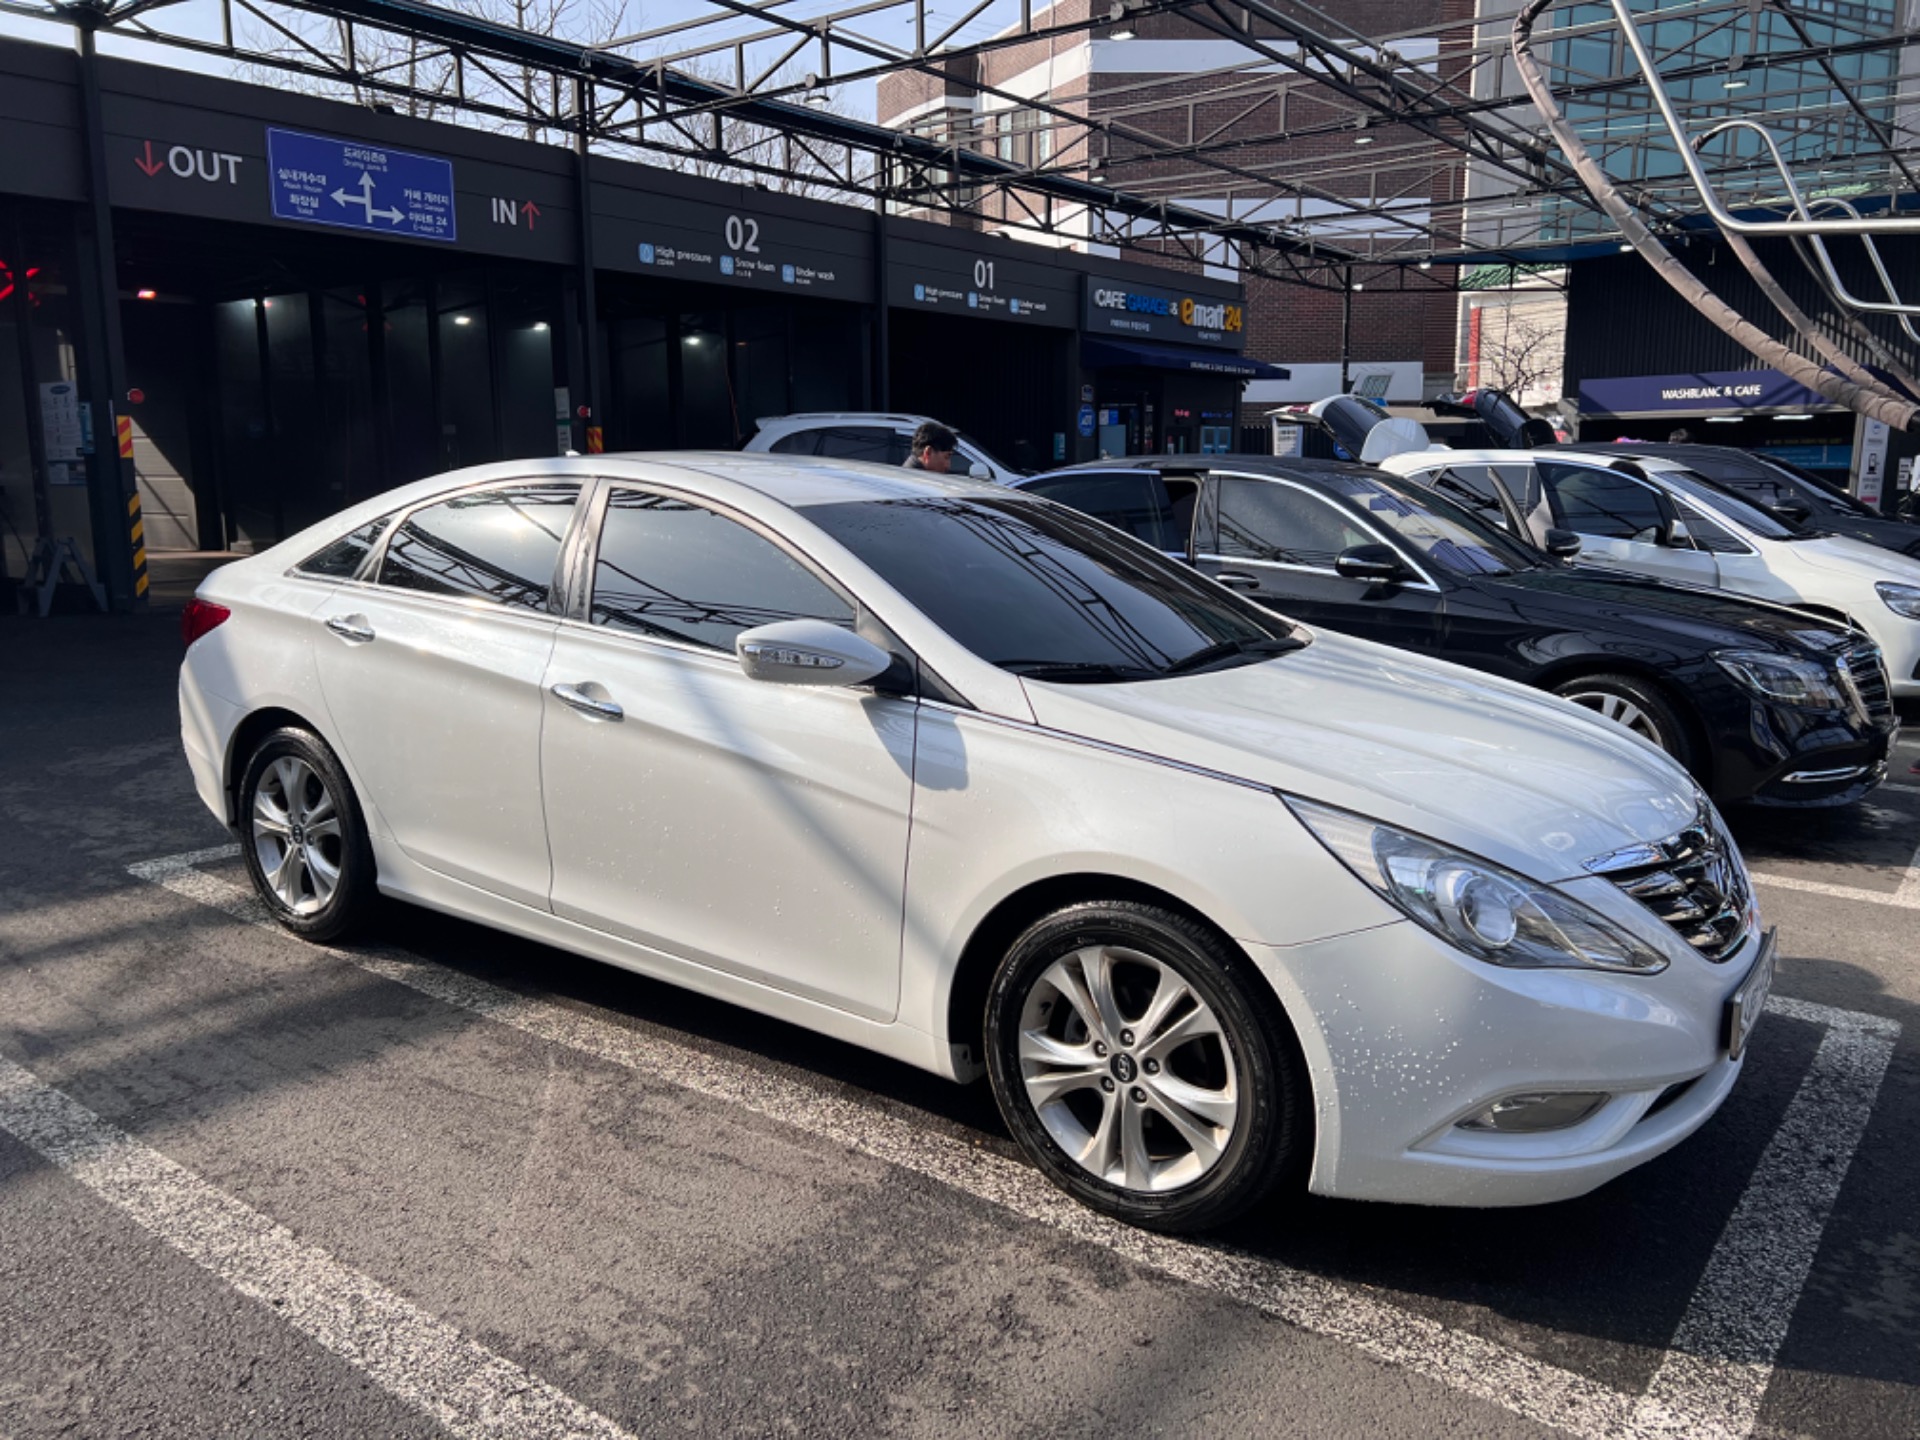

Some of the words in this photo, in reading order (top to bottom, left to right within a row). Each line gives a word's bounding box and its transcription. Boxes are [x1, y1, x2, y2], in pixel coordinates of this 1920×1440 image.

[168, 145, 243, 184] OUT
[492, 197, 517, 226] IN
[725, 215, 760, 254] 02
[655, 245, 675, 258] High
[974, 259, 994, 290] 01
[1095, 289, 1126, 310] CAFE
[1723, 386, 1732, 397] &
[1734, 384, 1762, 397] CAFE
